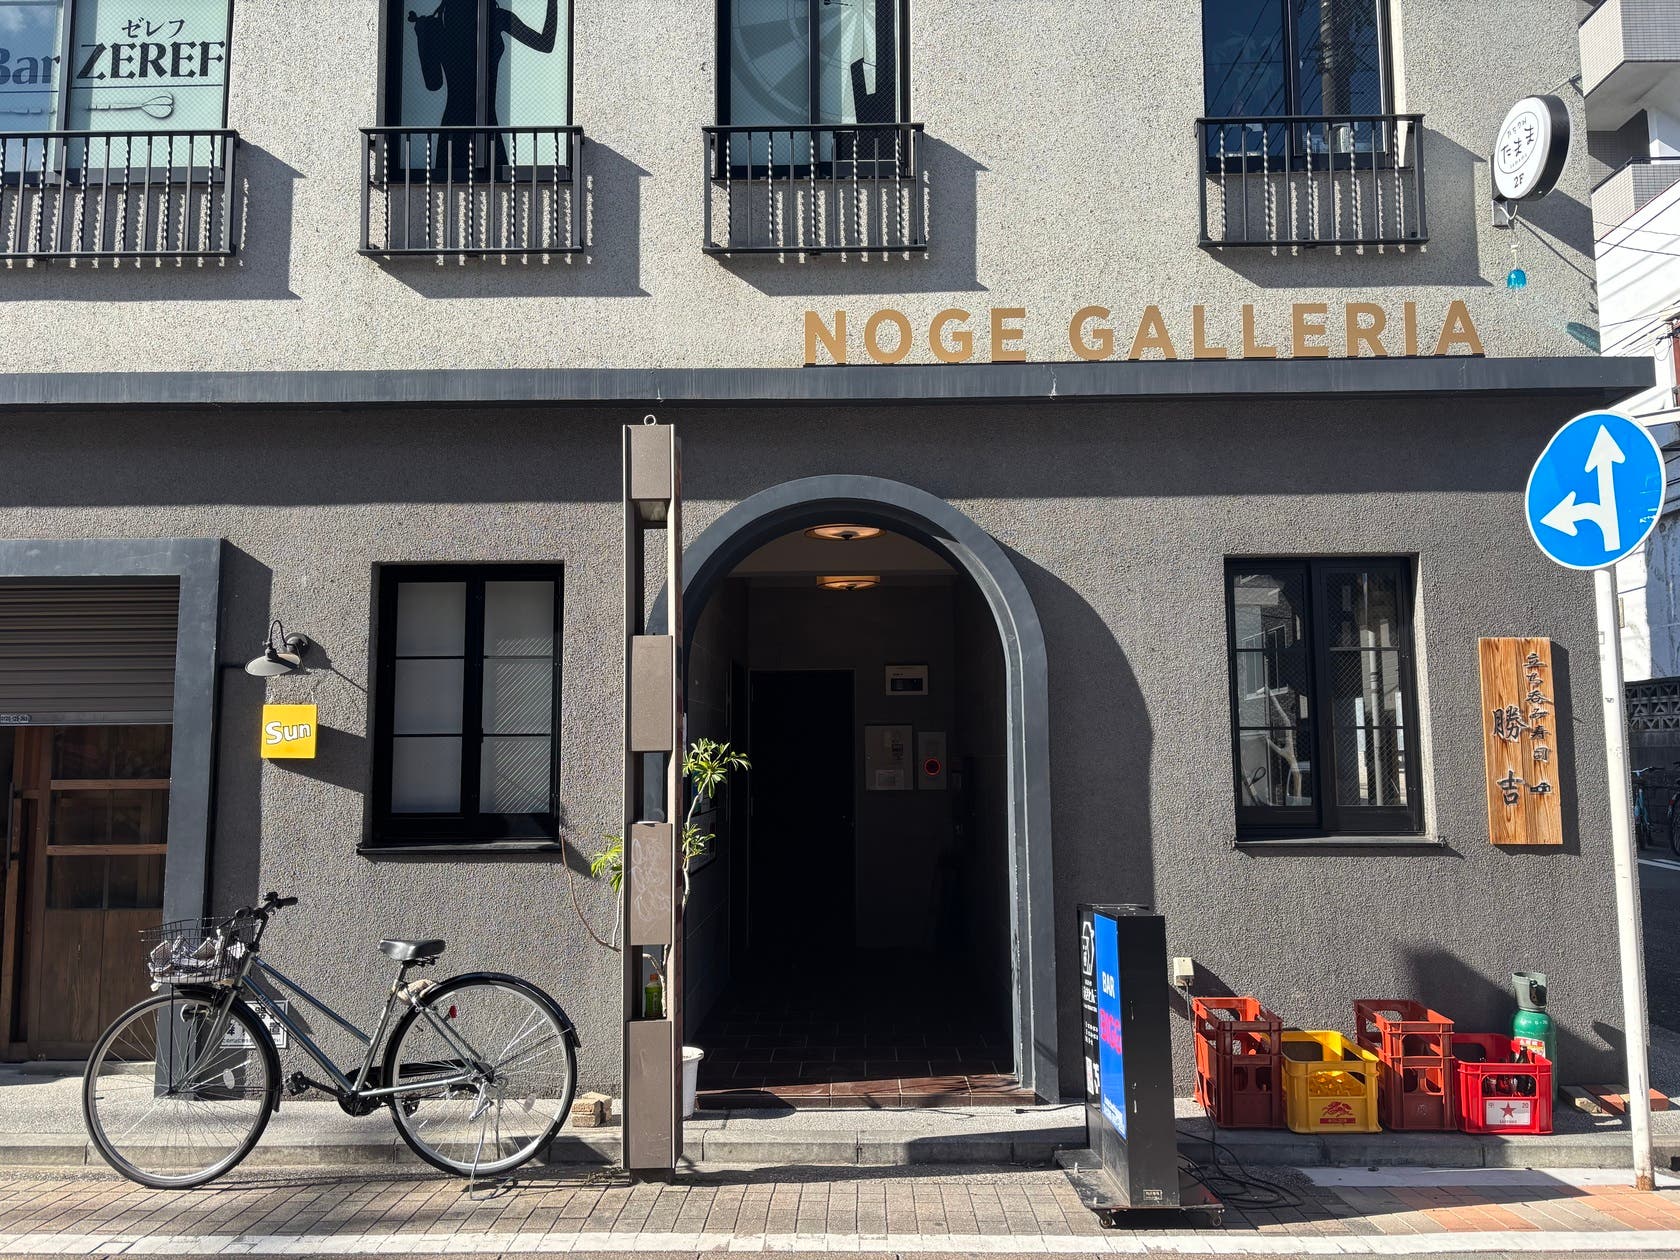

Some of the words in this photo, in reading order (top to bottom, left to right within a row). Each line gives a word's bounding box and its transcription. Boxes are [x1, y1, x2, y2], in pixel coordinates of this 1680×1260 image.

[122, 17, 186, 39] ゼレフ
[76, 40, 226, 80] ZEREF
[1513, 172, 1525, 189] 2F
[804, 308, 1027, 366] NOGE
[1068, 300, 1486, 361] GALLERIA
[1522, 651, 1551, 763] 立ち呑み寿司
[265, 720, 312, 746] Sun
[1492, 704, 1527, 806] 勝吉
[1102, 970, 1116, 999] BAR
